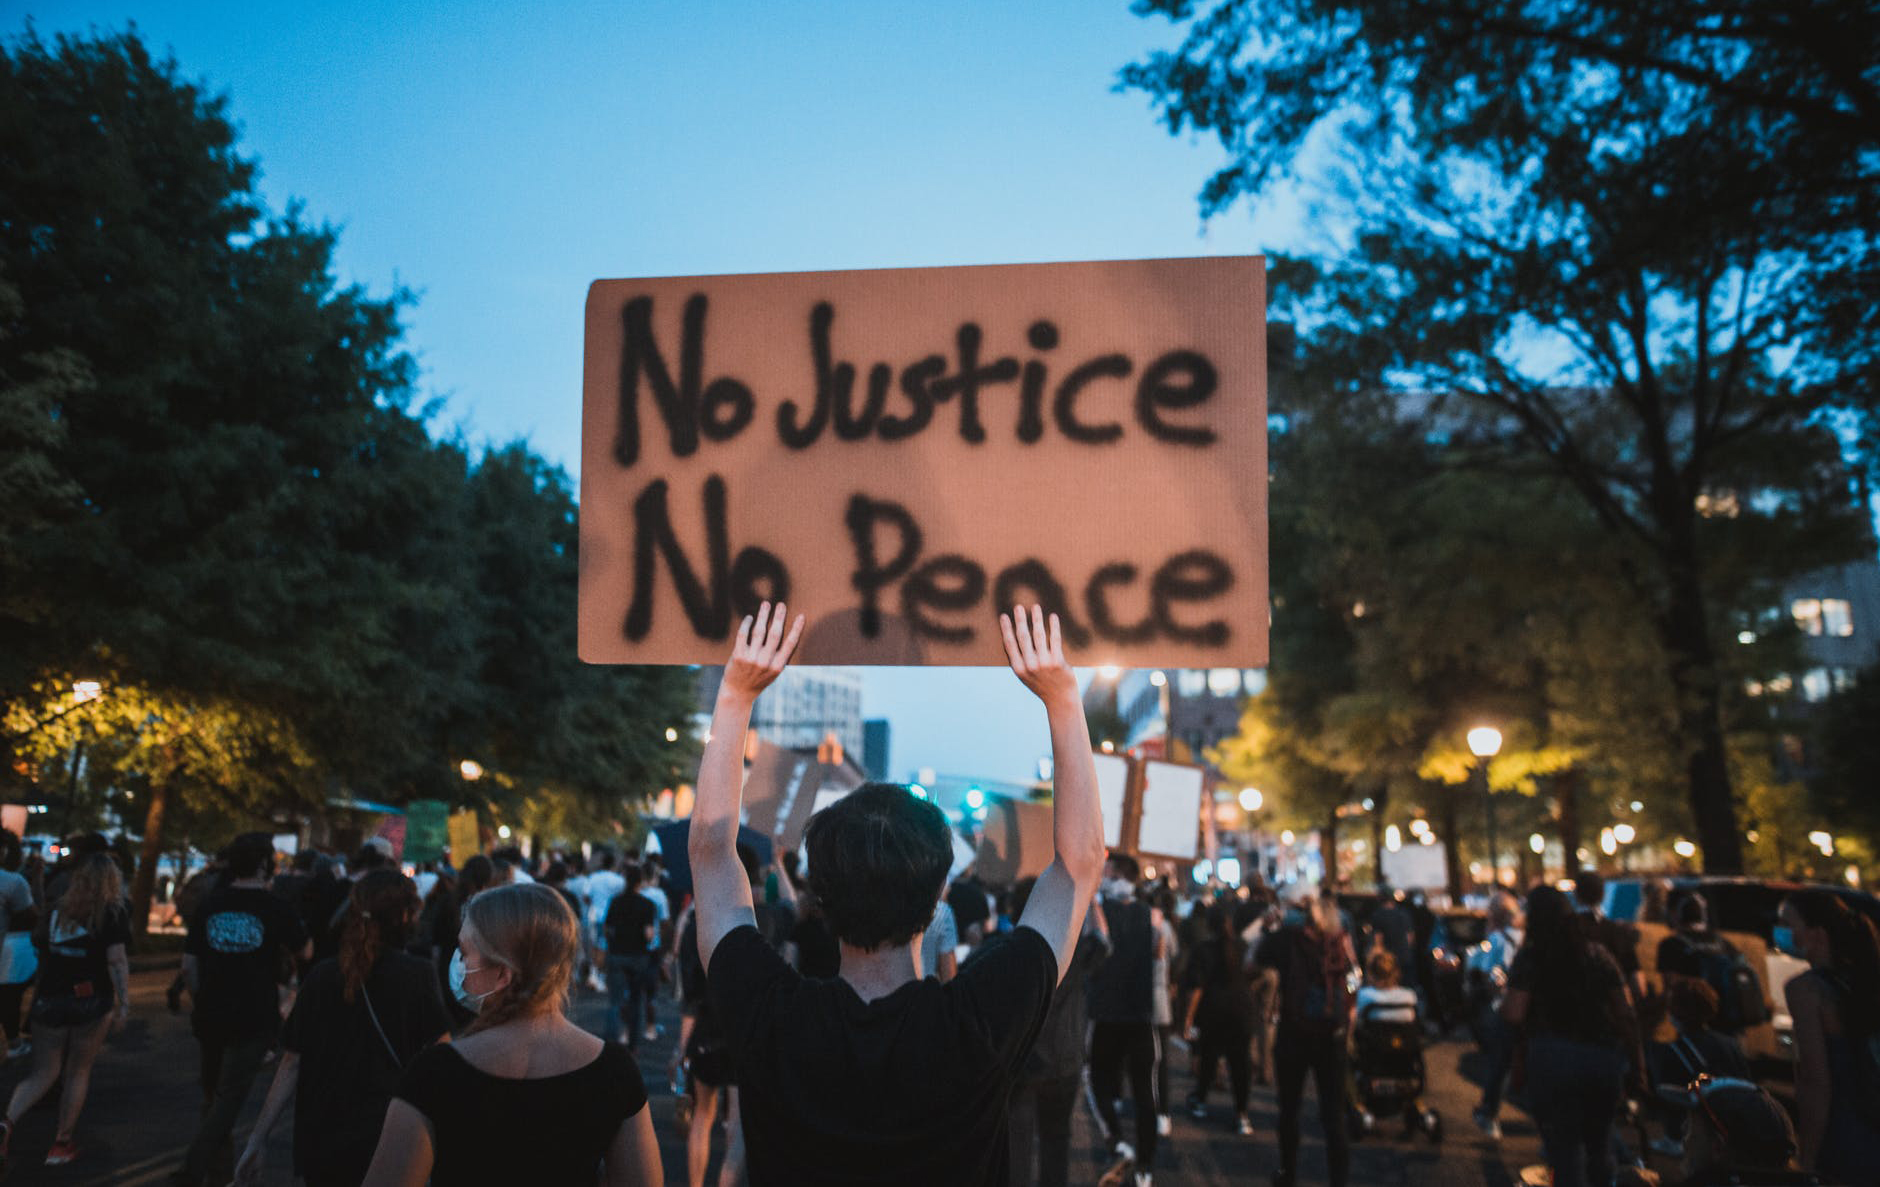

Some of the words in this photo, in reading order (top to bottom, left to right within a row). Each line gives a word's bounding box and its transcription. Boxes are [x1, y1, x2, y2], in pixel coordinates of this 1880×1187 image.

[613, 292, 755, 468] No
[777, 301, 1219, 450] Justice
[623, 475, 790, 644] No
[845, 494, 1233, 650] Peace
